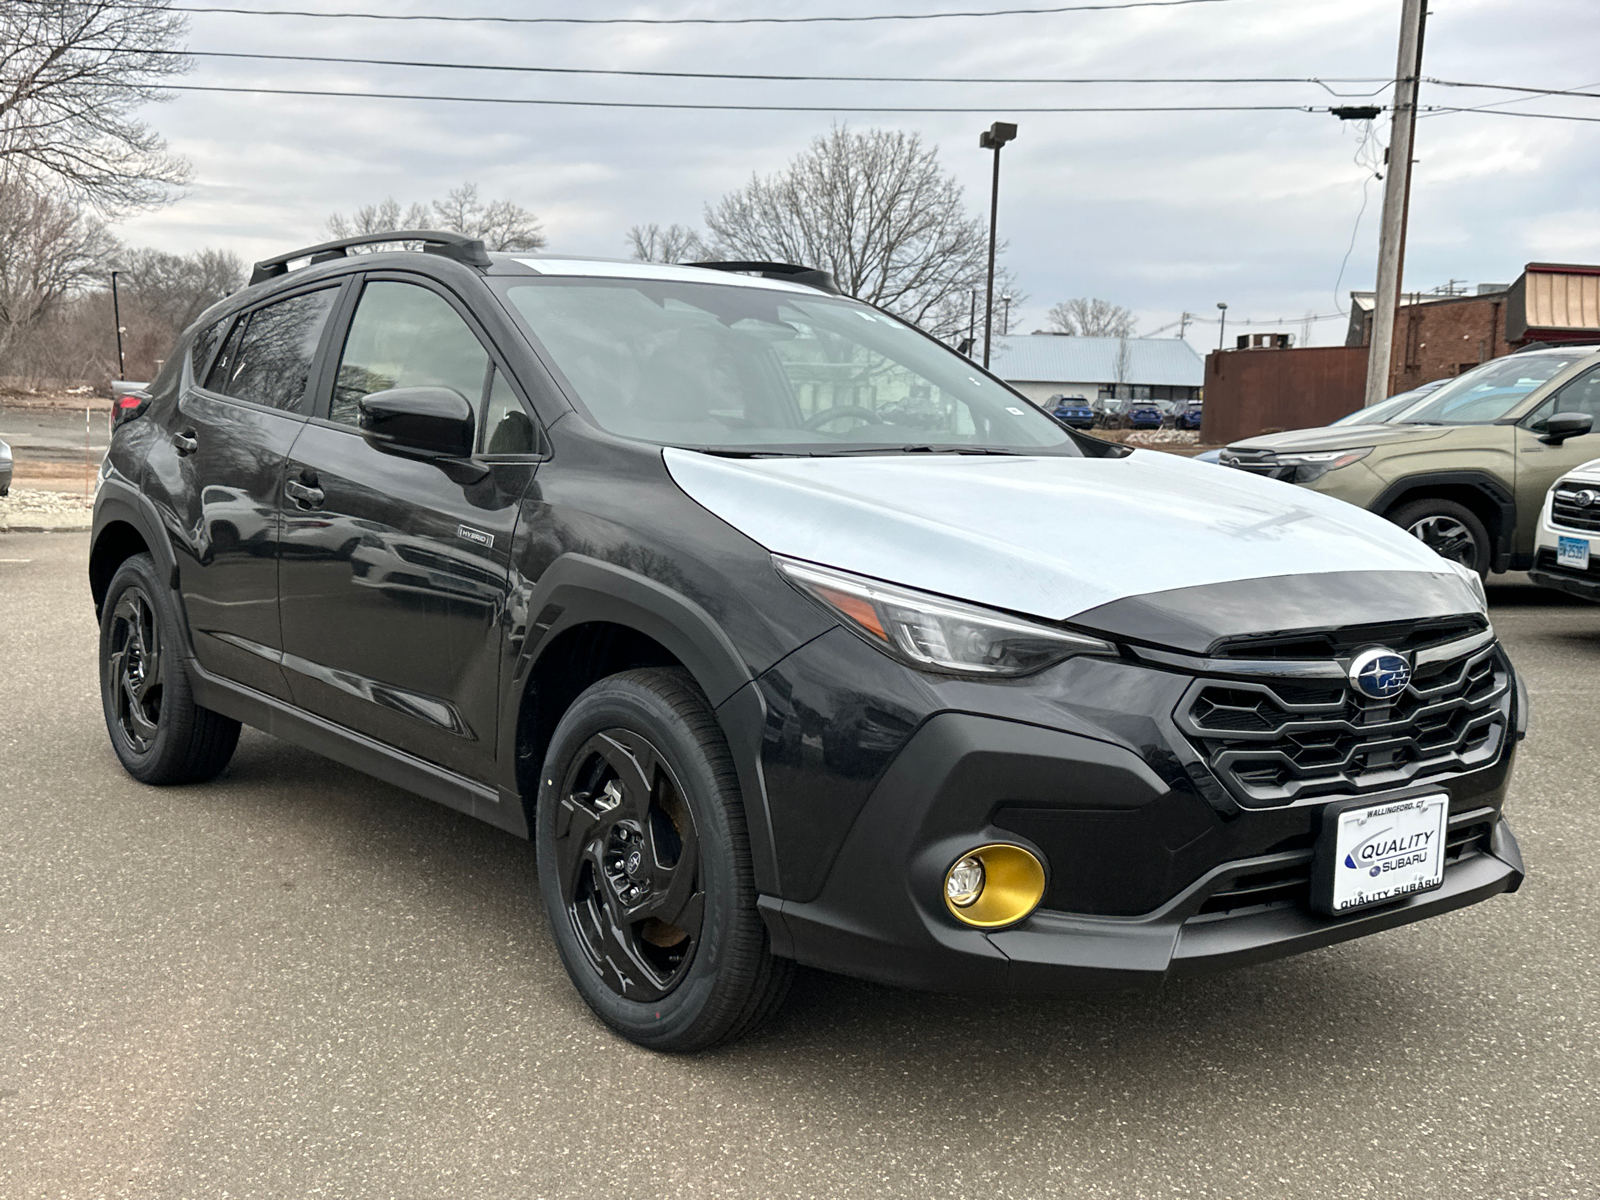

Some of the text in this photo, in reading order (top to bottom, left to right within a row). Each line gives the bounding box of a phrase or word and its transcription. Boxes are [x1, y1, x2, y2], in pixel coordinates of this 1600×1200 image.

[462, 530, 487, 543] HYBRID
[1416, 800, 1425, 809] CT
[1361, 830, 1435, 859] QUALITY
[1382, 852, 1427, 873] SUBARU
[1340, 877, 1440, 909] QUALITY SUBARU
